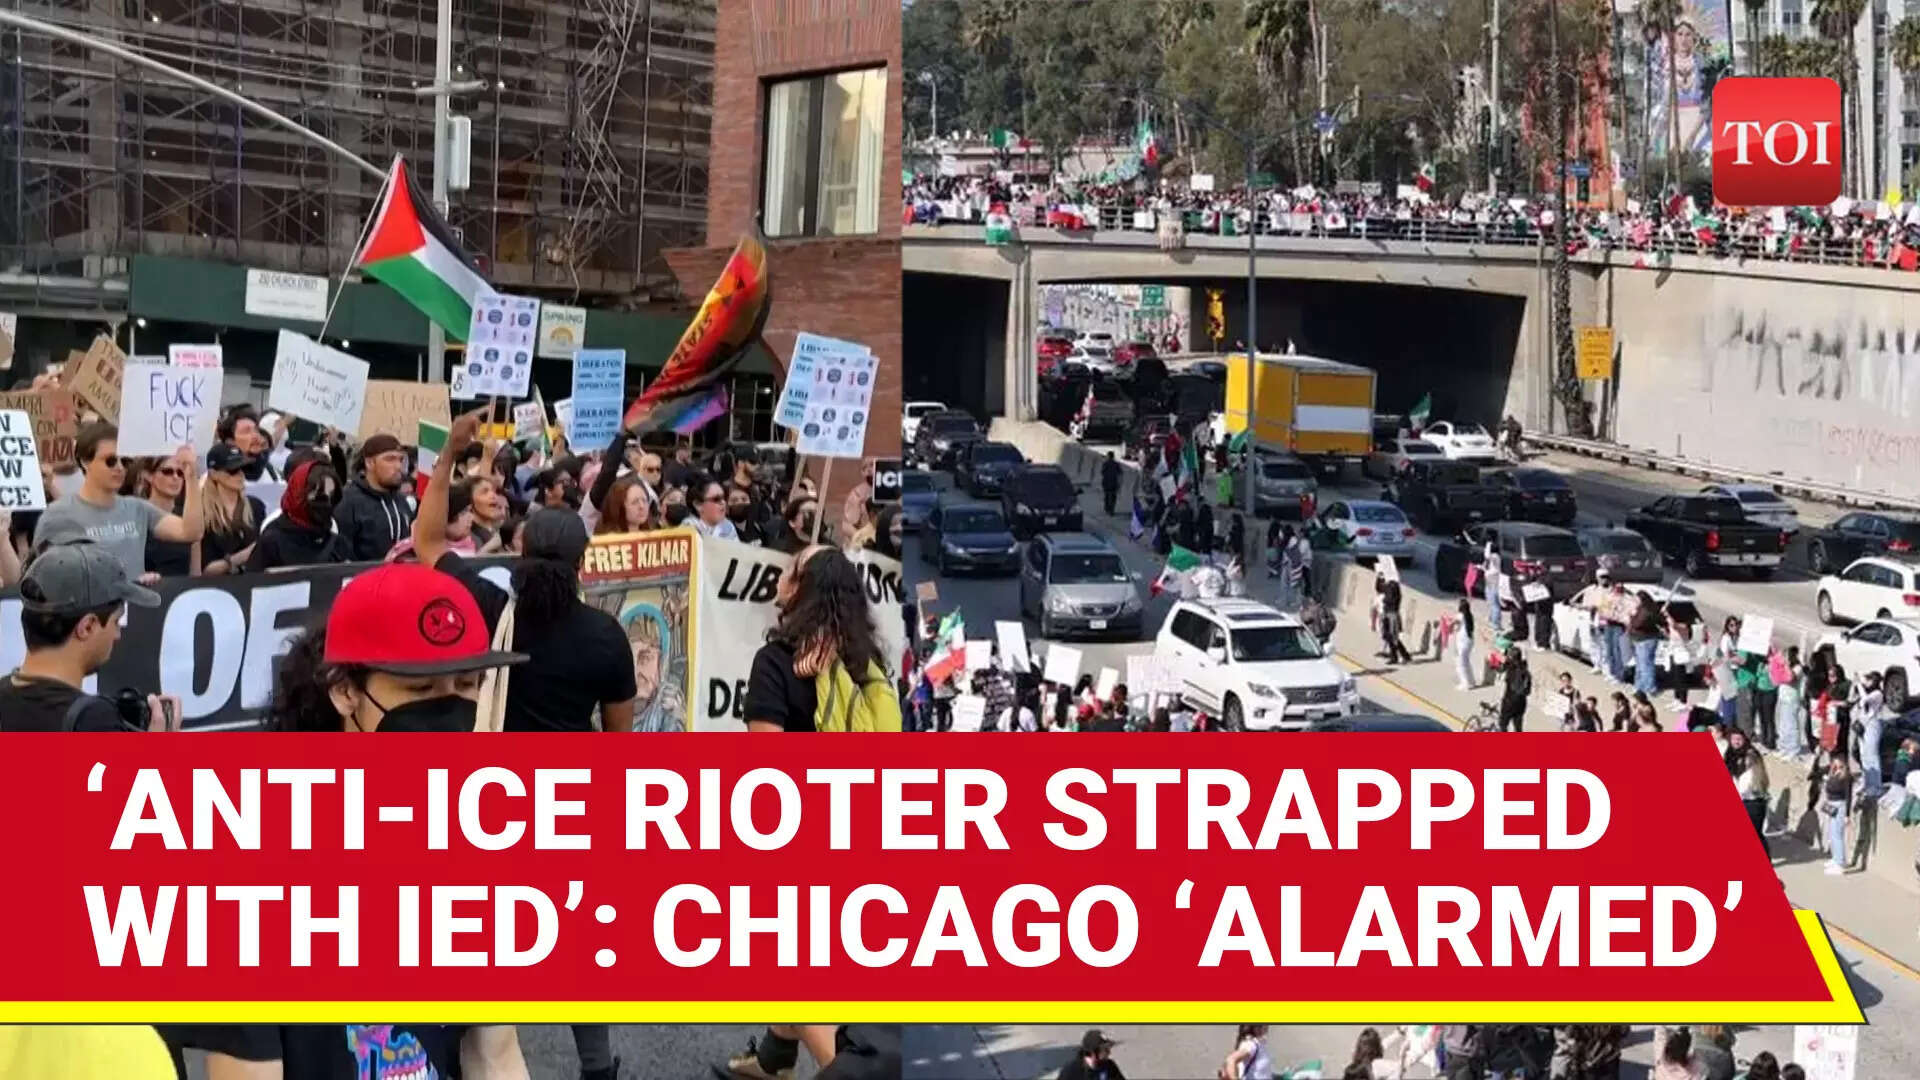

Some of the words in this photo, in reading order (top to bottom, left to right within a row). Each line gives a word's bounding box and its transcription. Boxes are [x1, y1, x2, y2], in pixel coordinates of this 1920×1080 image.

[150, 373, 205, 410] FUCK
[164, 411, 195, 442] ICE
[0, 436, 35, 457] CE
[583, 544, 633, 573] FREE
[637, 539, 690, 569] KILMAR
[159, 581, 311, 719] OF
